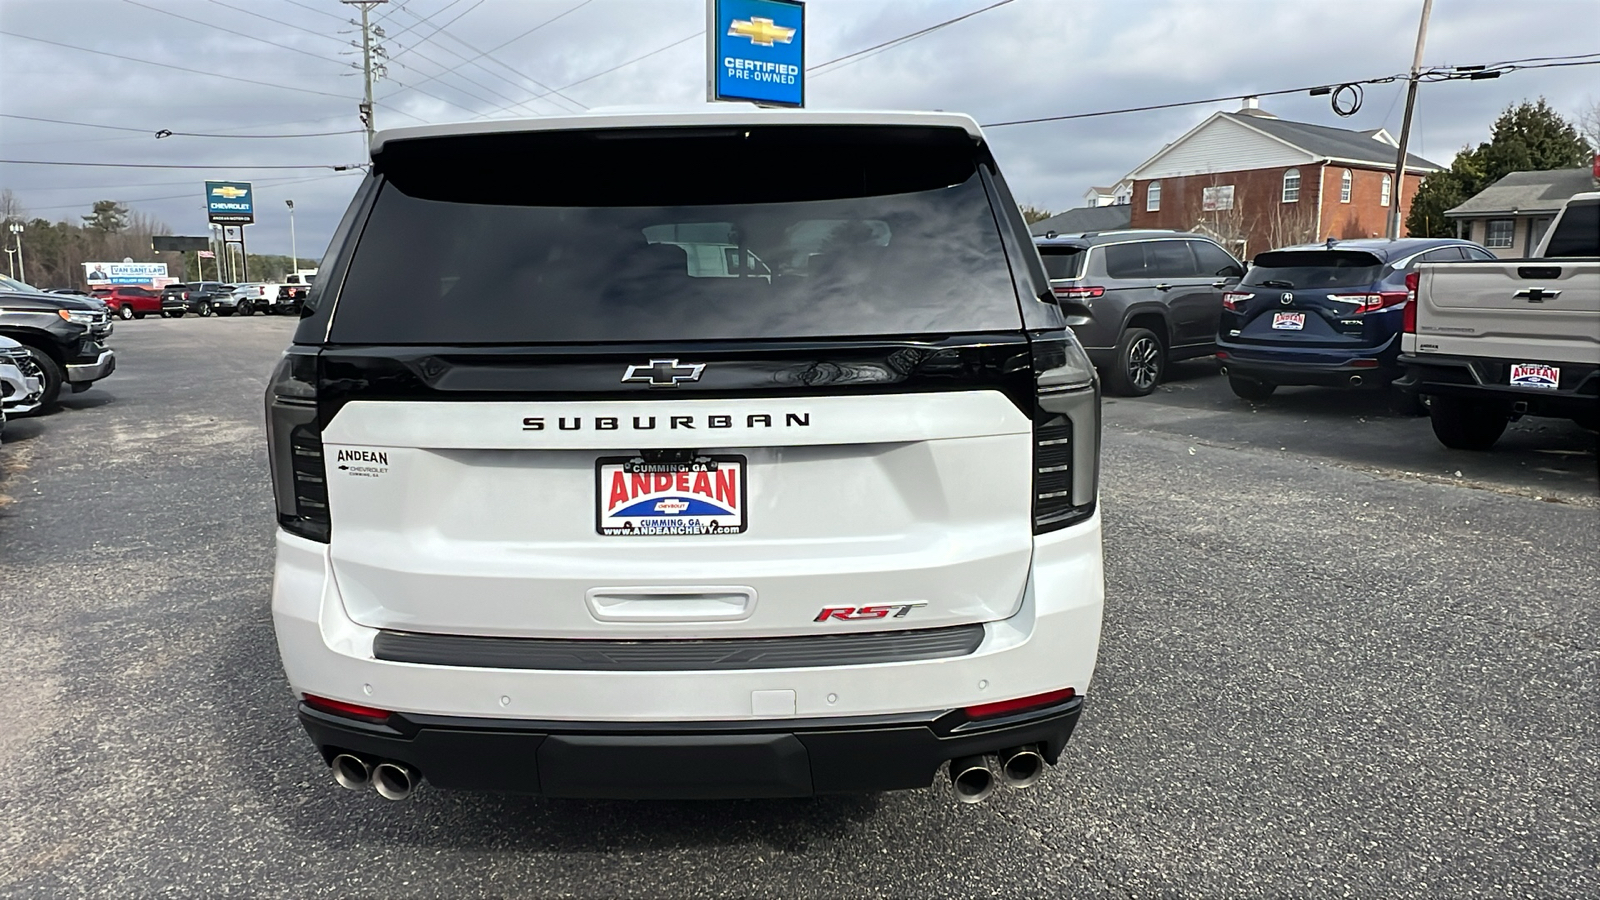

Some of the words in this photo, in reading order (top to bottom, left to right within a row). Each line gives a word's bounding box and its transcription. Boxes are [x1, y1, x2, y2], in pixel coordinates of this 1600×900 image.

[724, 57, 799, 76] CERTIFIED
[728, 68, 795, 85] PRE-OWNED
[1275, 313, 1304, 323] ANDEAN
[1513, 367, 1557, 382] ANDEAN
[522, 413, 810, 431] SUBURBAN
[337, 449, 389, 466] ANDEAN
[633, 464, 689, 473] CUMMING,
[692, 464, 708, 473] GA
[608, 468, 737, 512] ANDEAN
[603, 526, 740, 535] www.ANDEANCHEVY.com
[640, 519, 686, 528] CUMMING,
[813, 600, 928, 622] RST
